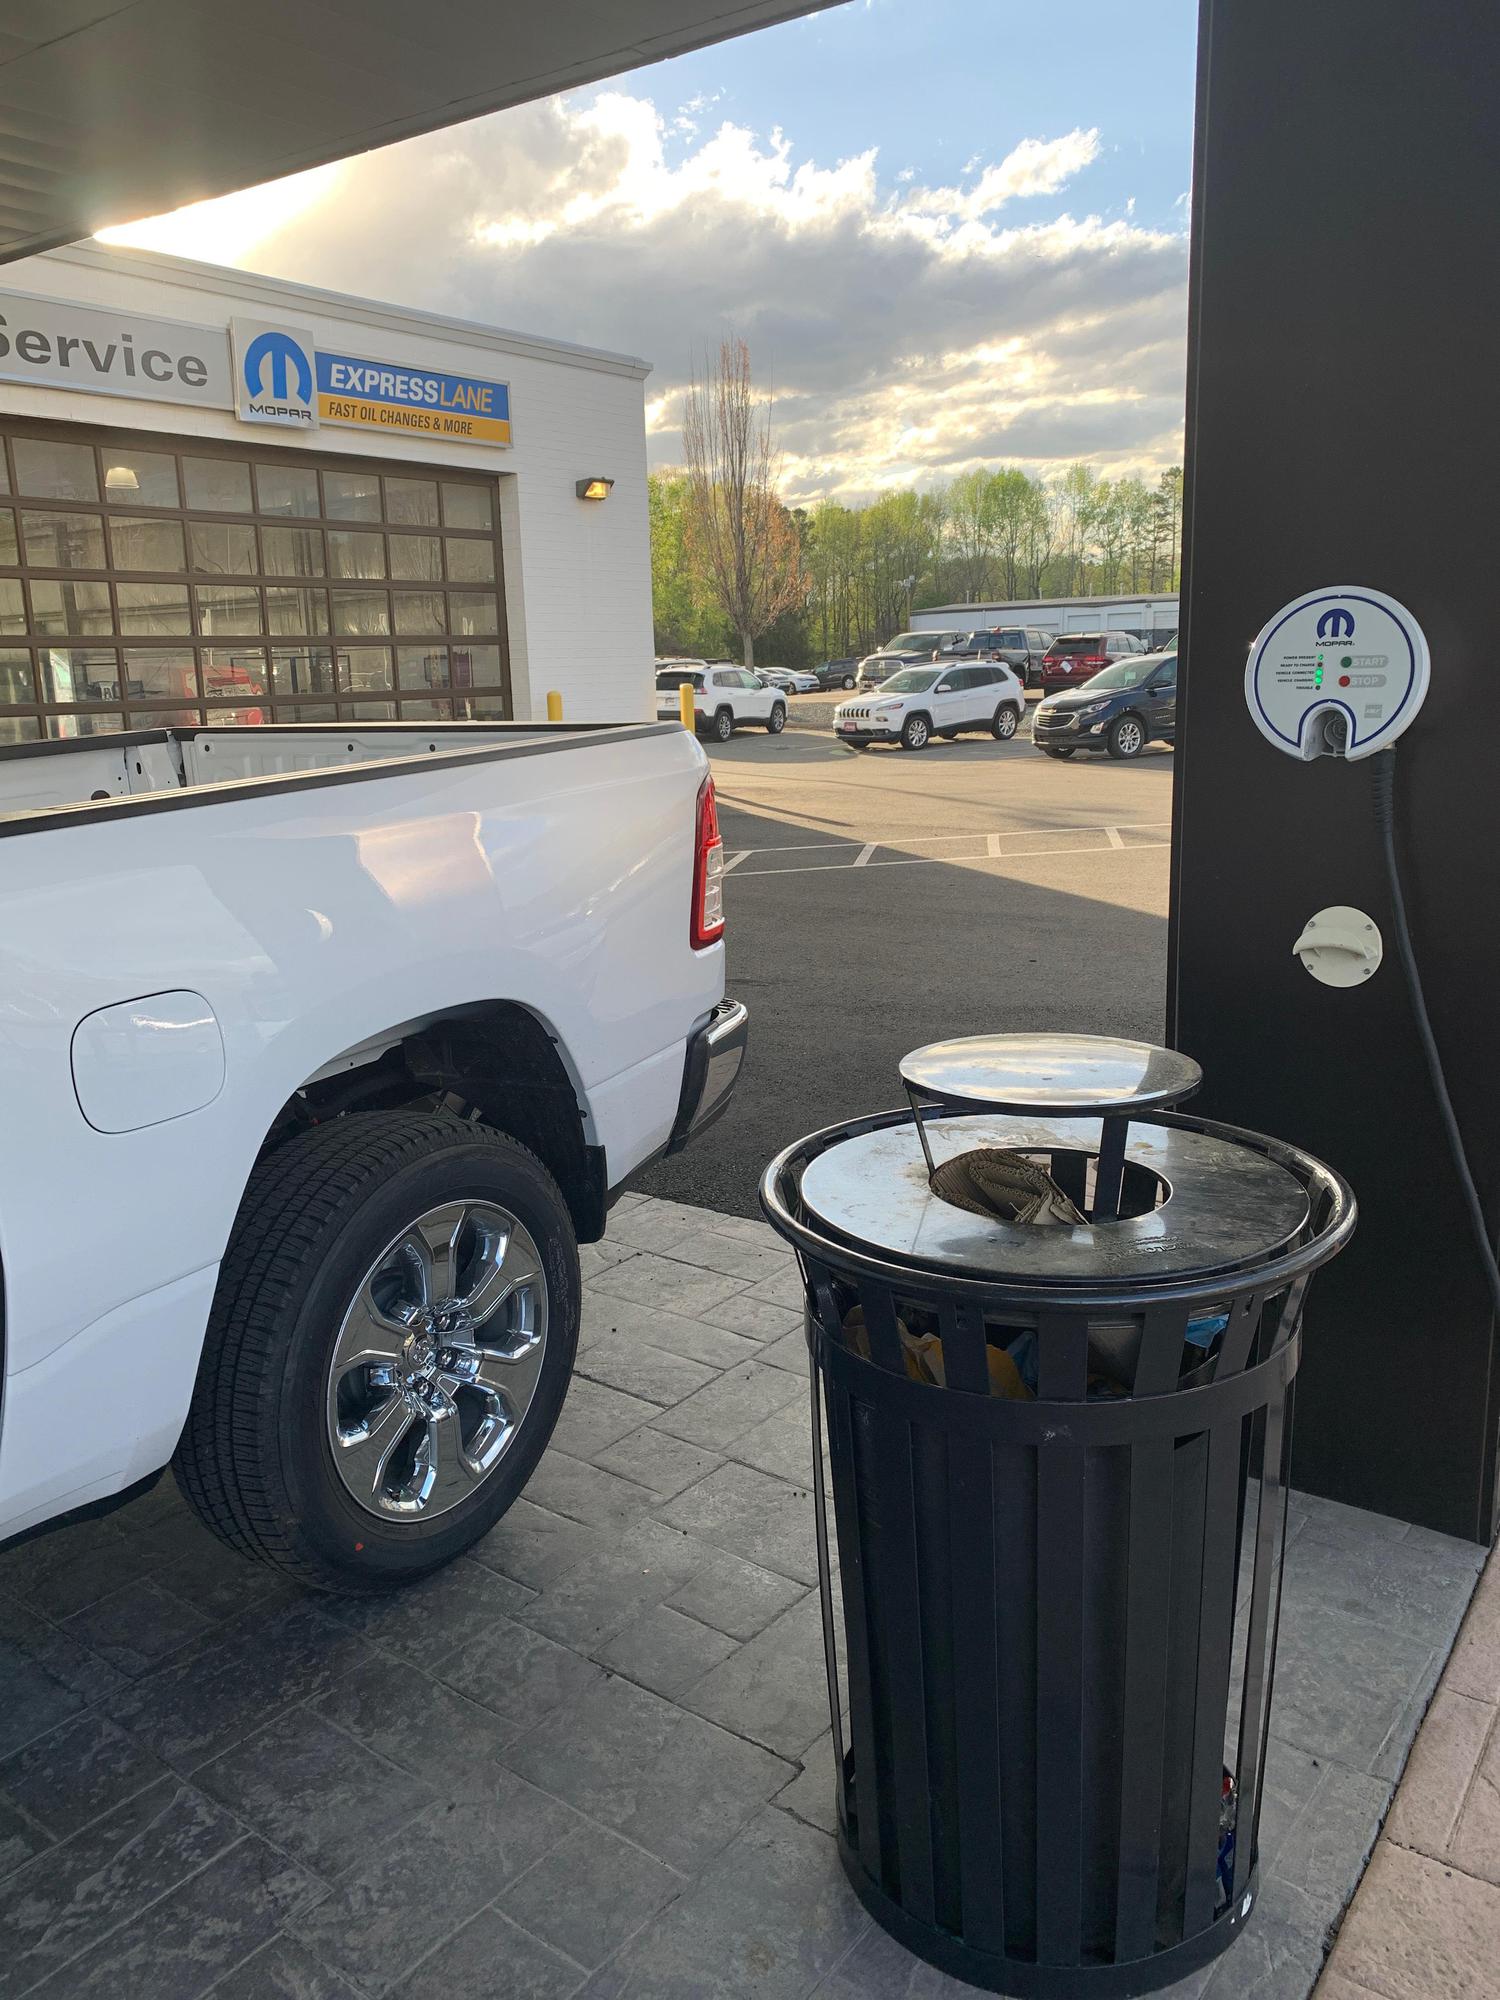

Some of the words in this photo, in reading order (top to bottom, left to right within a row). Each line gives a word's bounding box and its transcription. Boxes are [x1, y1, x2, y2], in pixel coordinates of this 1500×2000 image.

[0, 314, 208, 387] ervice
[249, 404, 312, 421] MOPAR
[329, 402, 357, 420] FAST
[360, 406, 378, 422] OIL
[380, 408, 431, 429] CHANGES
[433, 416, 441, 430] &
[443, 419, 473, 435] MORE
[1353, 657, 1385, 666] START
[1351, 676, 1378, 686] STOP
